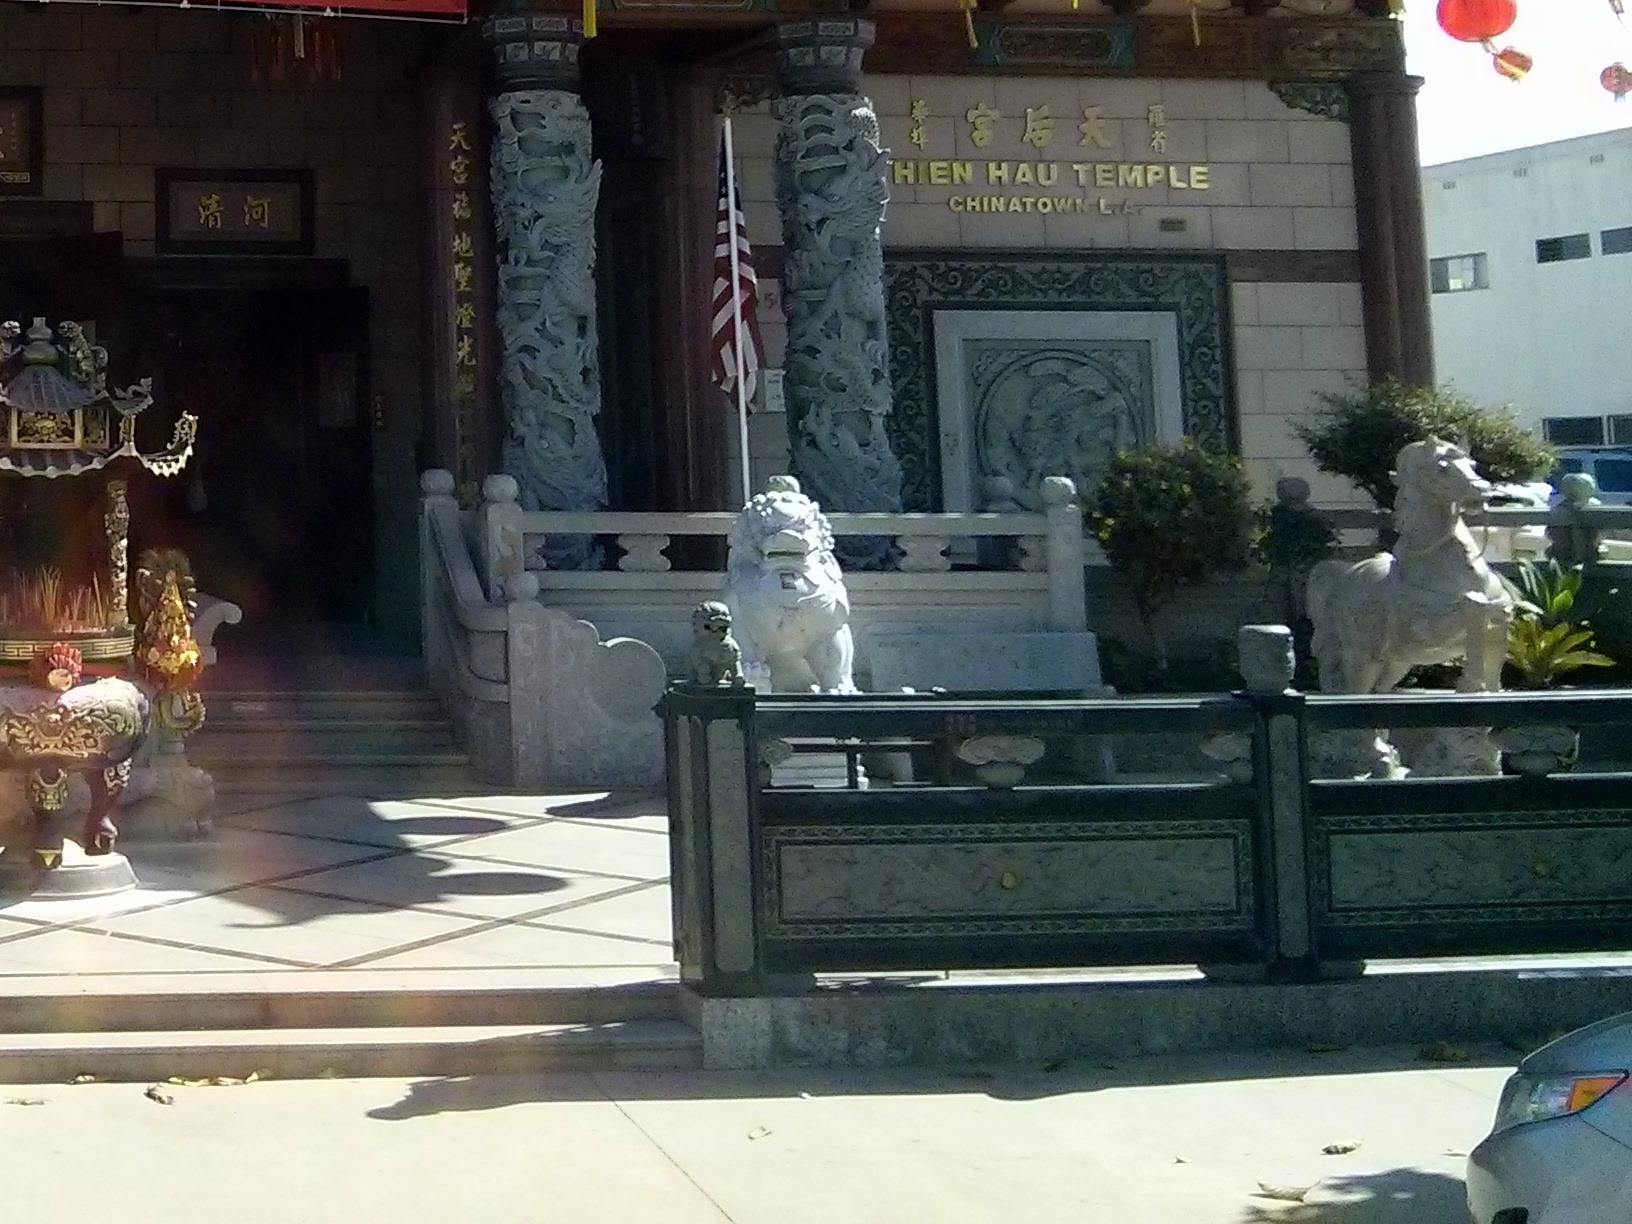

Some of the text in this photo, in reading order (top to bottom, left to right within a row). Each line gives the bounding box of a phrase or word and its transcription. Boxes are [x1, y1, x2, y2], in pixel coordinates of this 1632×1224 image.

[967, 101, 1113, 150] 天后宮
[893, 161, 1210, 190] HIEN HAU TEMPLE
[948, 194, 1144, 216] CHINATOWN L.A.
